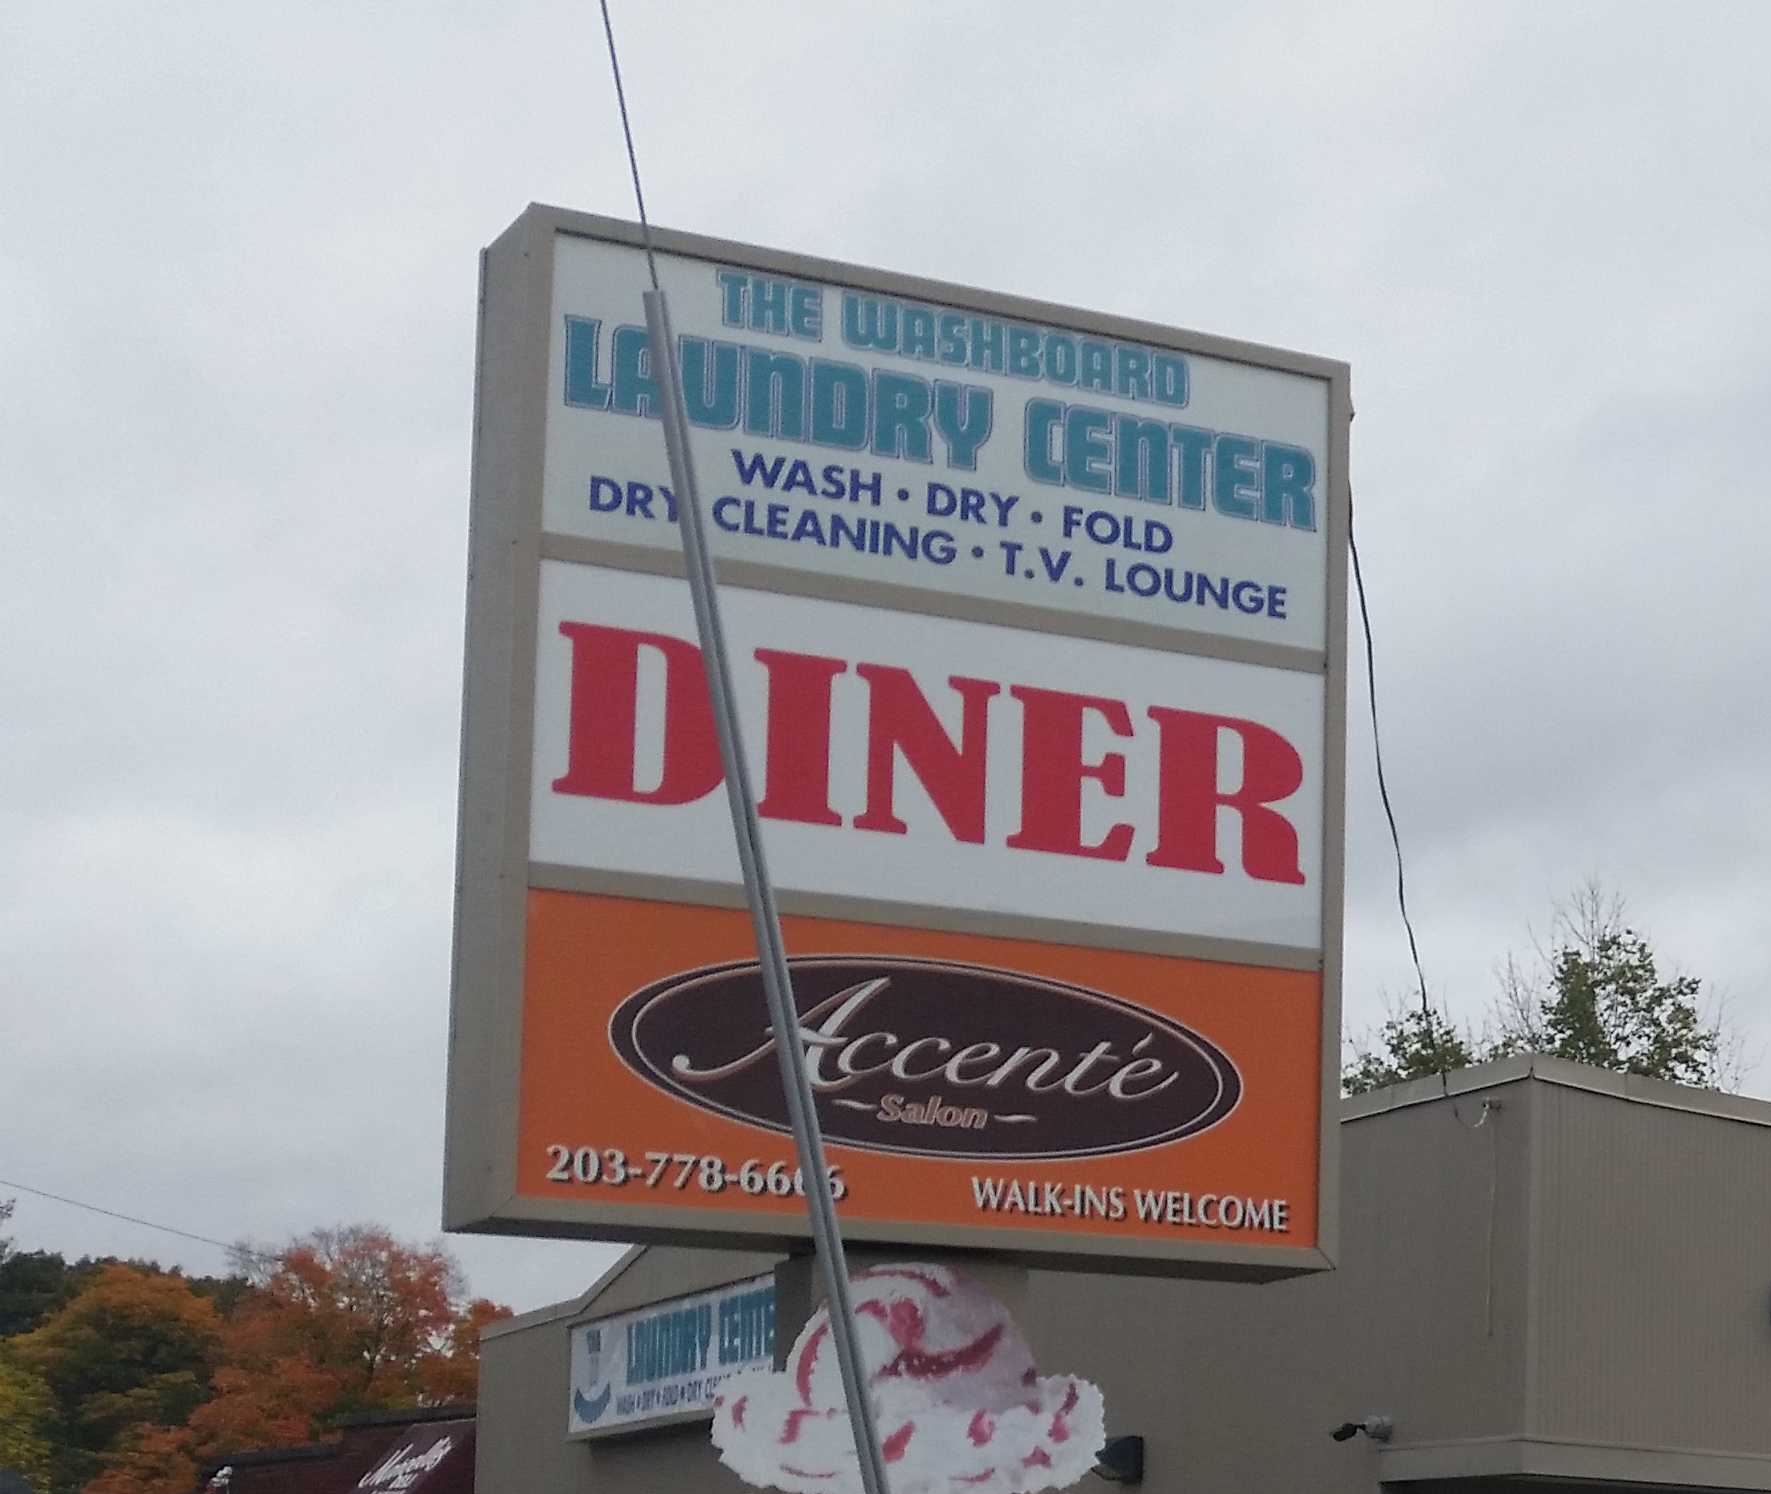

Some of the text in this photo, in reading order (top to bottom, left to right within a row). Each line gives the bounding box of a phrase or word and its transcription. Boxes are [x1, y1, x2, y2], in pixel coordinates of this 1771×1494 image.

[716, 268, 1190, 408] THE WASHBOARD
[565, 314, 1317, 533] LAUNDRY CENTER
[712, 496, 958, 565] CLEANING
[1001, 541, 1084, 588] T.V.
[1105, 559, 1288, 620] LOUNGE
[731, 449, 1174, 555] WASH DRY FOLD
[552, 621, 1306, 886] DINER
[671, 977, 1179, 1100] Accenté
[545, 1144, 847, 1200] 203-778-666
[877, 1095, 989, 1130] Salon
[971, 1176, 1290, 1232] WALK-INS WELCOME
